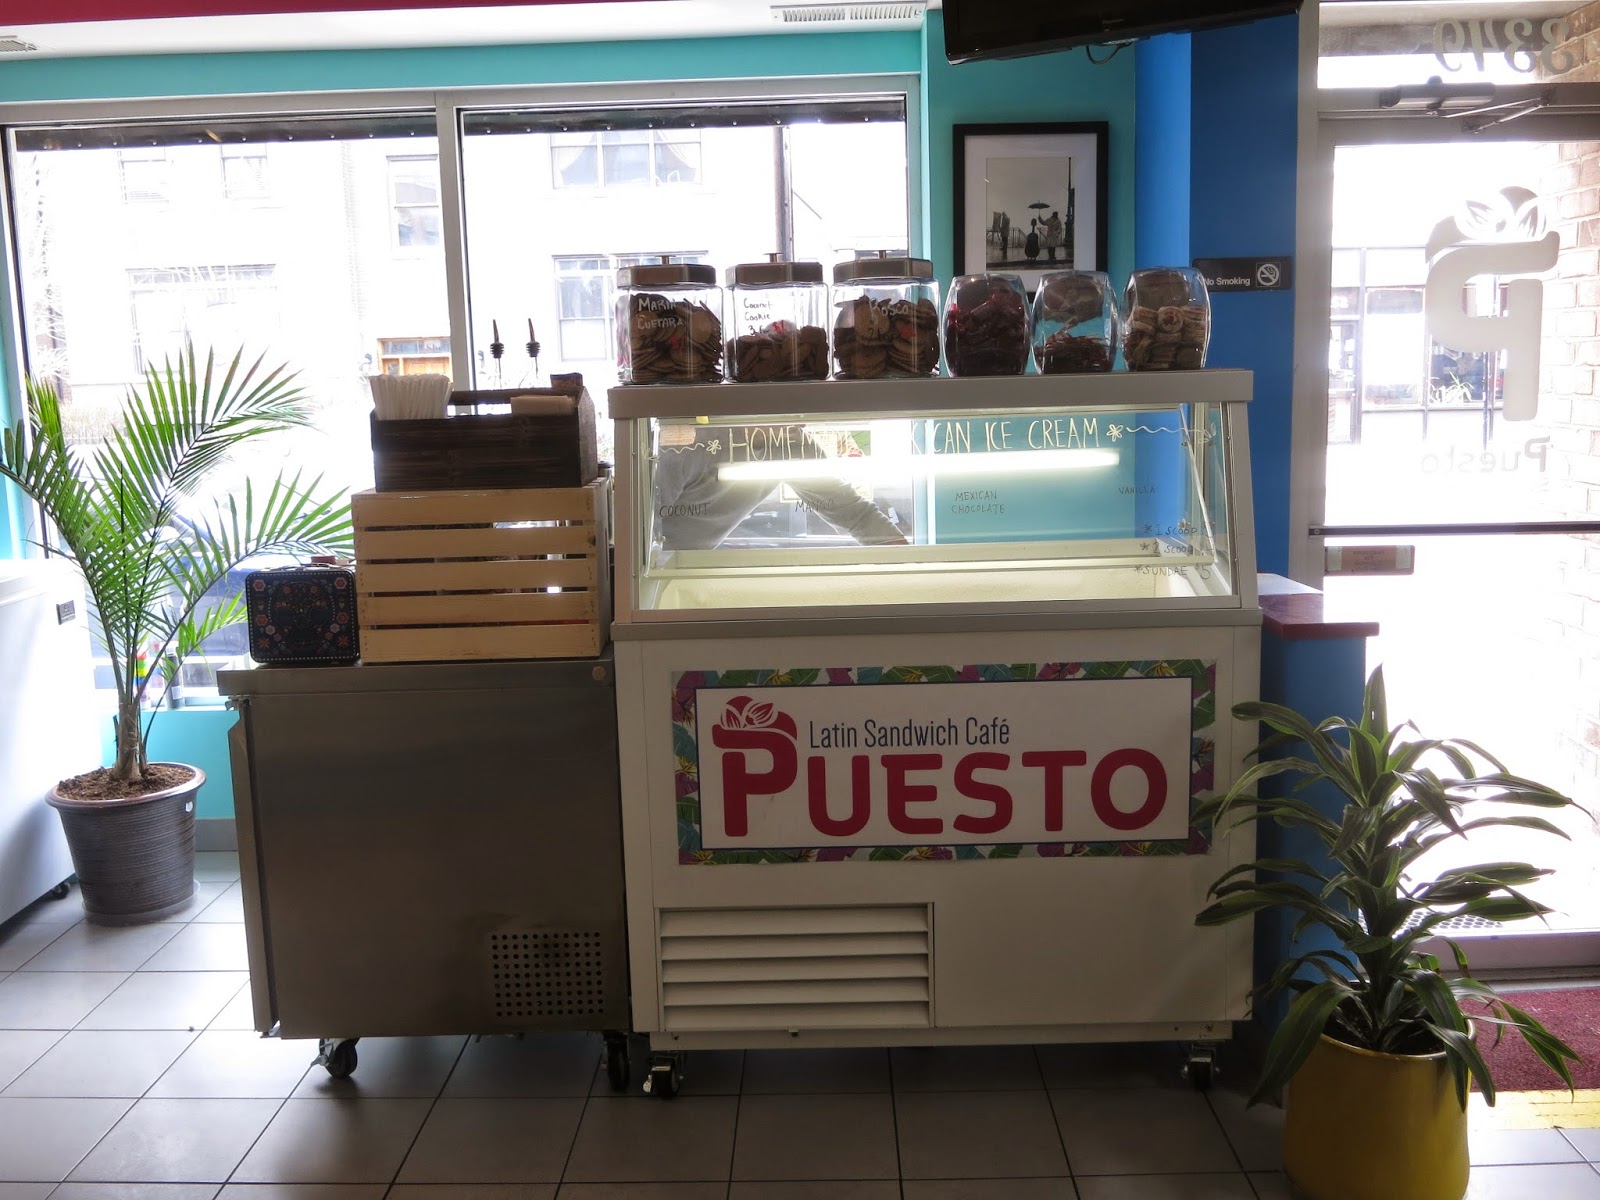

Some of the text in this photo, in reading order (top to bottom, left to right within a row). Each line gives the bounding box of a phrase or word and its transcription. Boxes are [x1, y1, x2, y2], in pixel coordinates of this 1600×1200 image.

[1216, 277, 1250, 287] Smoking
[744, 311, 772, 322] Cookie
[984, 420, 1012, 452] ICE
[1027, 417, 1100, 449] CREAM
[954, 490, 998, 502] MEXICAN
[659, 502, 711, 518] COCONUT
[794, 499, 835, 513] MANGO
[951, 503, 1005, 514] CHOCOLATE
[1142, 565, 1188, 576] SUNDAE
[808, 716, 1010, 750] Latin Sandwich Café
[711, 708, 1168, 837] PUESTO
